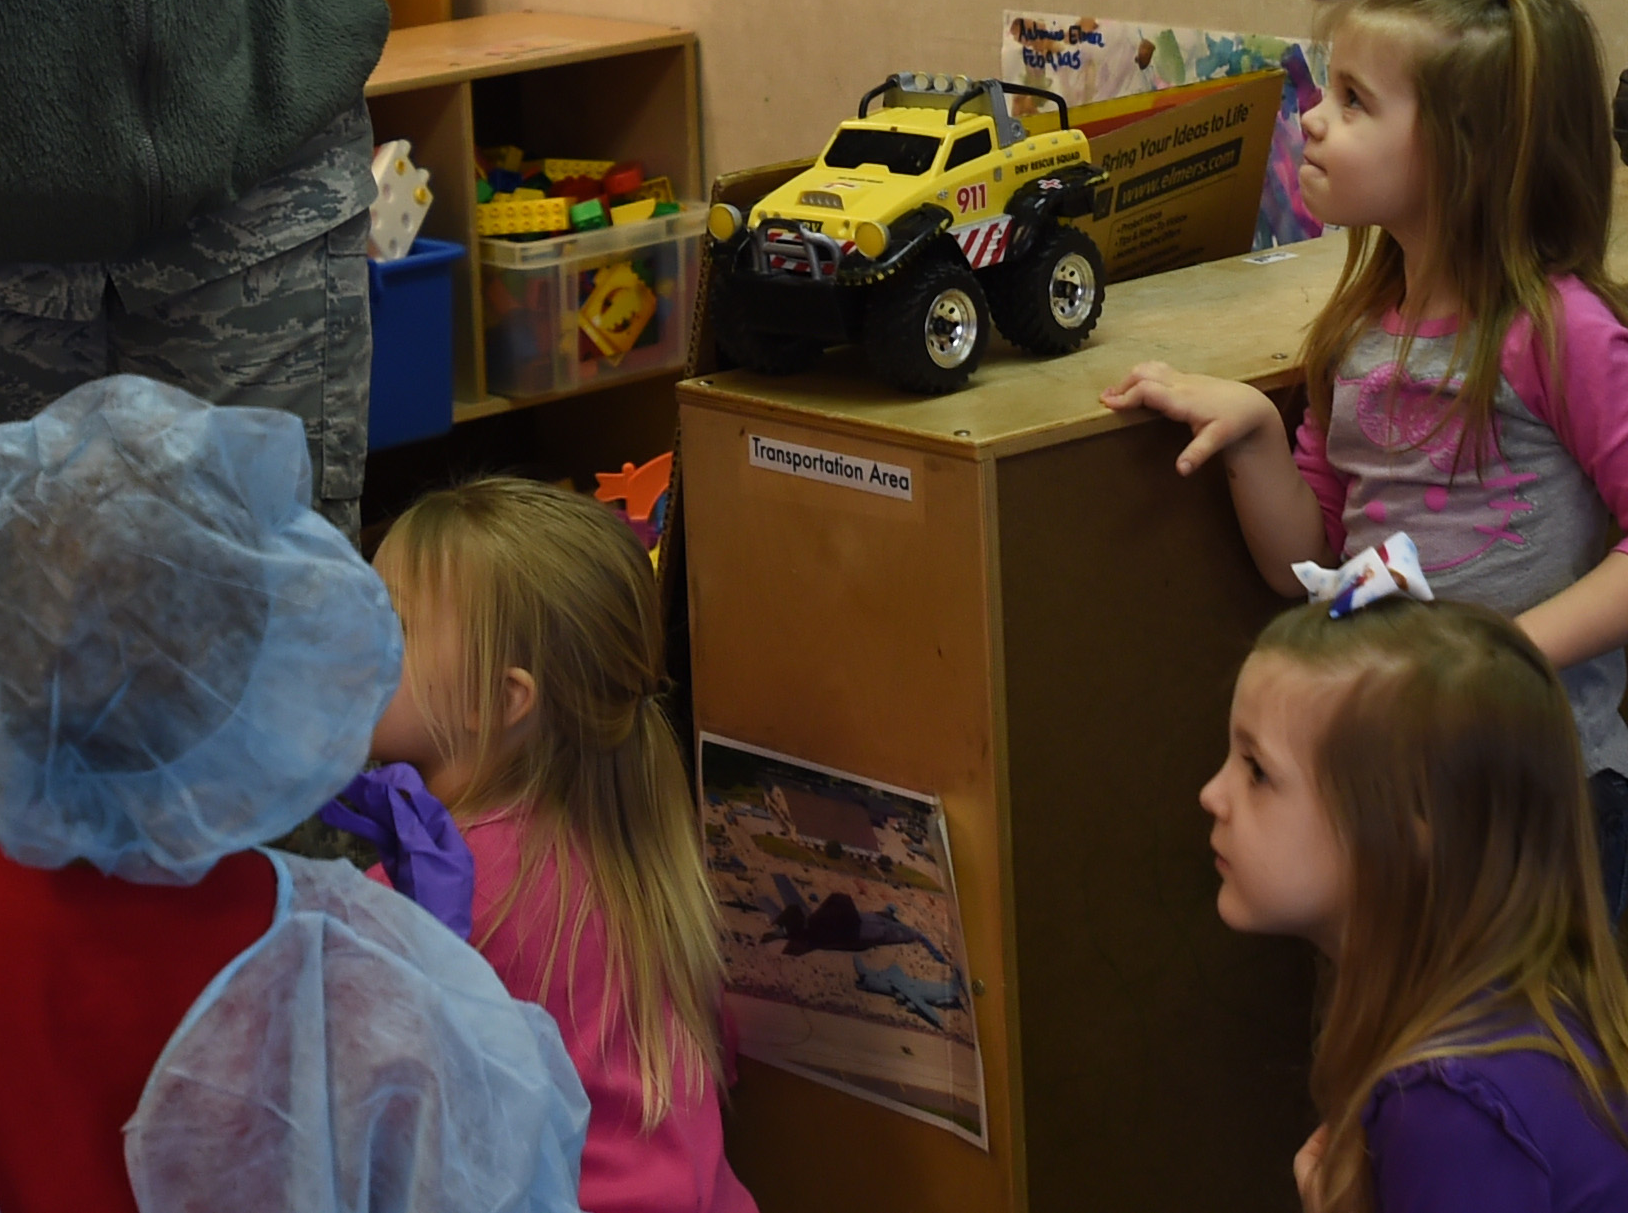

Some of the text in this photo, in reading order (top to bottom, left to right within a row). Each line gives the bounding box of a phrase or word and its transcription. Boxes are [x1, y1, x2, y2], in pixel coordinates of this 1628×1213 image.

[1102, 148, 1137, 172] Bring
[1140, 137, 1172, 159] Your
[1173, 120, 1209, 149] Ideas
[1211, 114, 1224, 133] to
[957, 184, 986, 214] 911
[1122, 149, 1235, 204] www.elmers.com
[752, 436, 910, 490] Transportation Area
